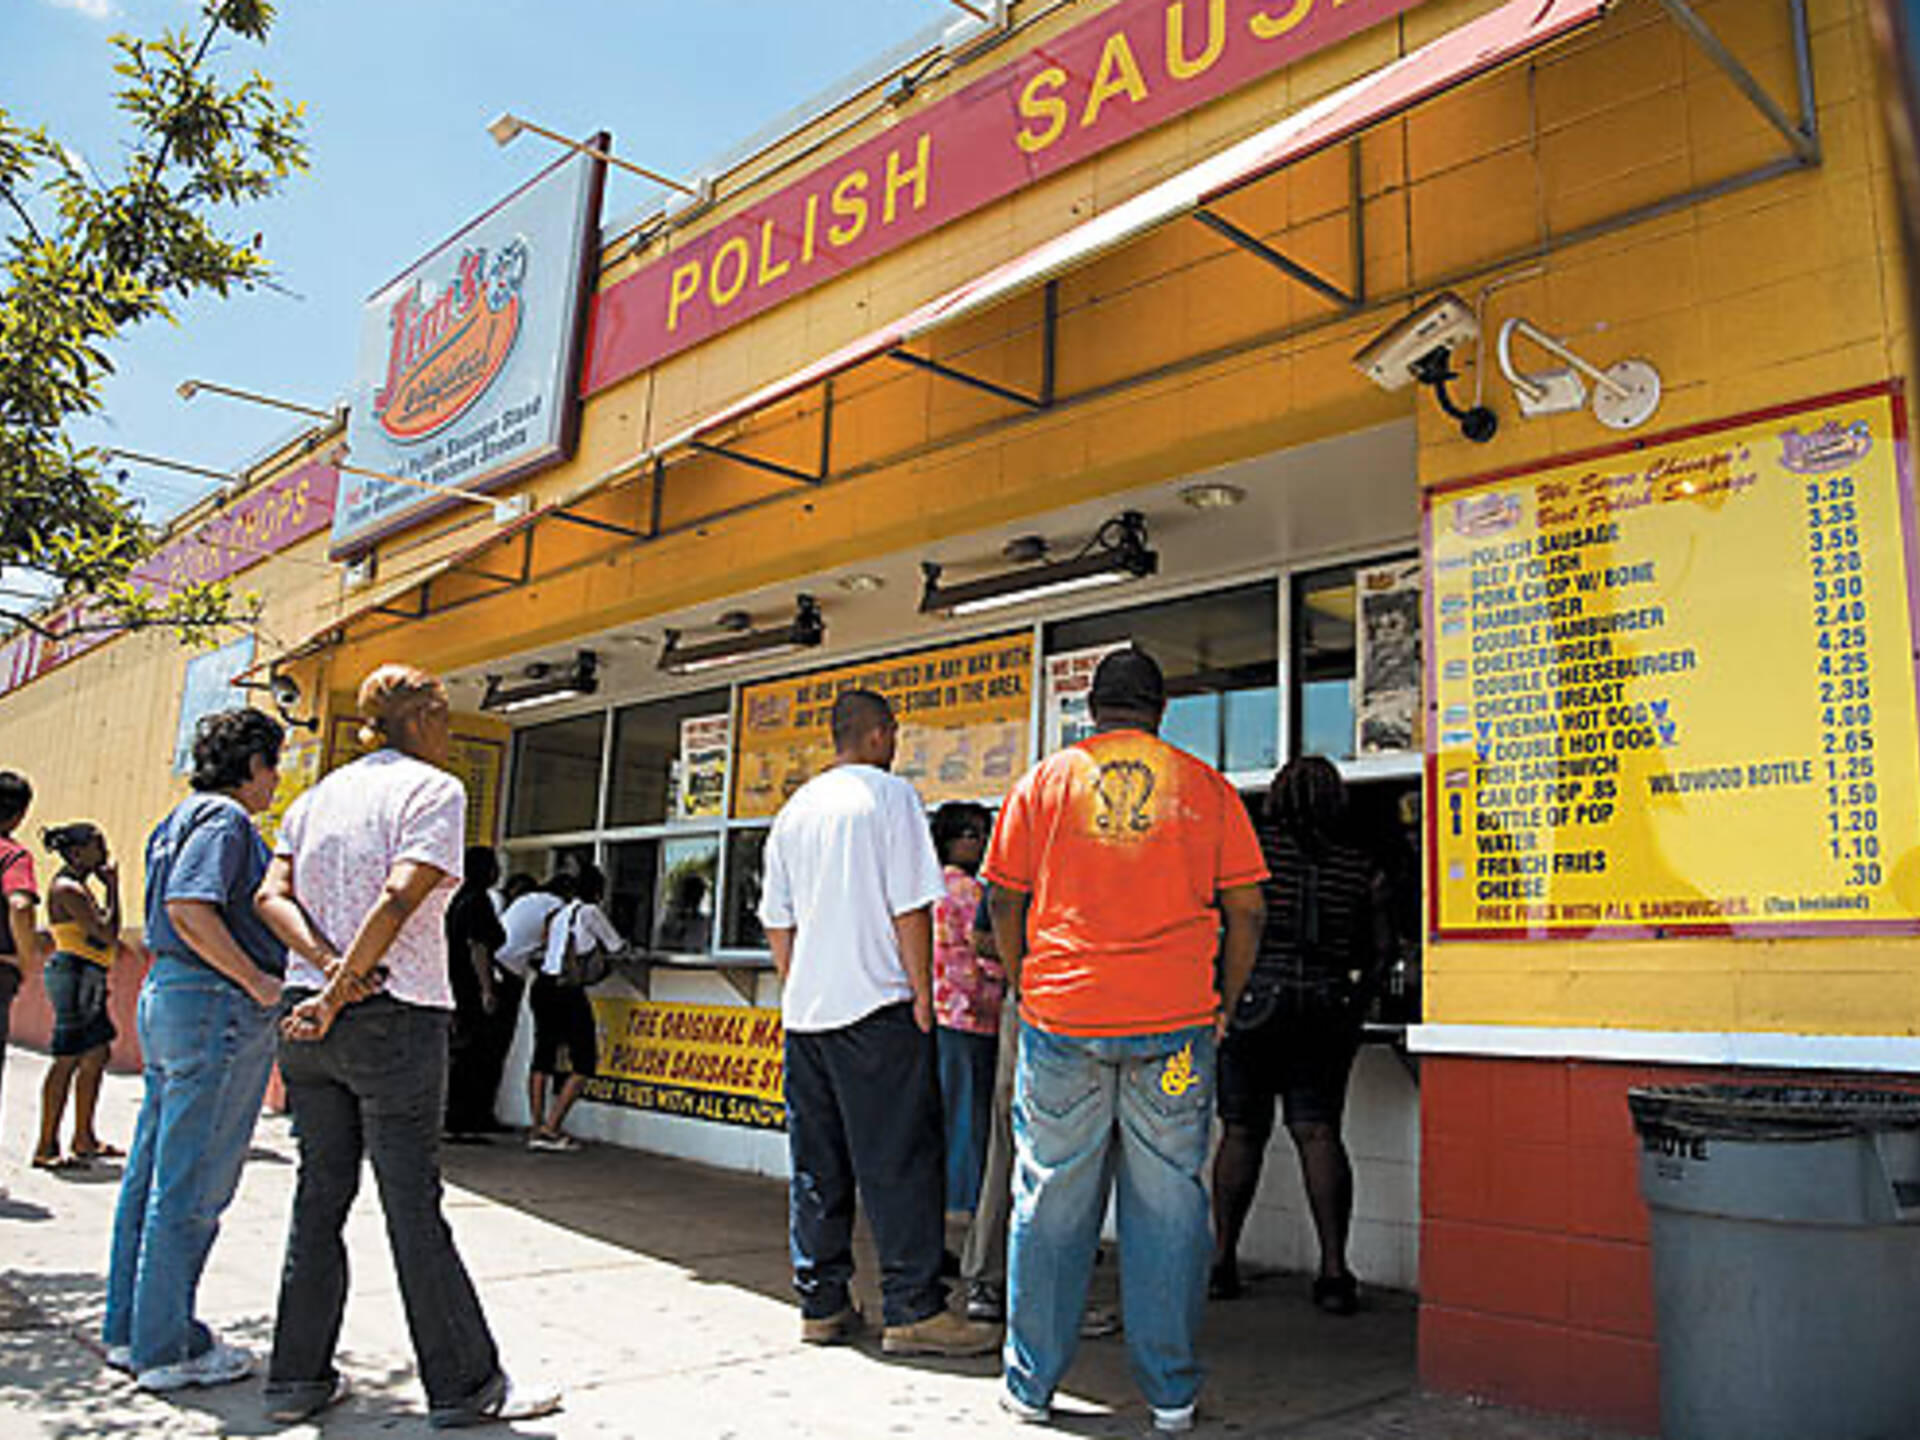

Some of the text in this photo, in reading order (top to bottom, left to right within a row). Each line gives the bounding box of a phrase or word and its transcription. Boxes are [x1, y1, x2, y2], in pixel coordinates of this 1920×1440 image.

[666, 132, 931, 332] POLISH
[1472, 477, 1855, 566] POLISH SAUSAGE 3.25
[1516, 552, 1581, 581] POLISH
[1808, 501, 1857, 528] 3.35
[1473, 586, 1517, 609] PORK
[1522, 577, 1571, 601] CHOP
[1604, 562, 1654, 588] BONE
[1810, 526, 1859, 553] 3.55
[1473, 597, 1583, 631] HAMBURGER
[1473, 575, 1863, 653] DOUBLE HAMBURGER 3.90
[1473, 601, 1866, 675] CHEESEBURGER 2.40
[1473, 626, 1867, 696] DOUBLE CHEESEBURGER 4.25
[1475, 652, 1870, 718] CHICKEN BREAST 4.25
[1562, 708, 1600, 731] HOT
[1605, 702, 1648, 727] DOG
[1819, 677, 1870, 703] 2.35
[1476, 730, 1874, 785] FISH SANDWICH 2.65
[1496, 735, 1565, 761] DOUBLE
[1569, 731, 1607, 753] HOT
[1612, 726, 1656, 750] DOG
[1476, 756, 1874, 808] CAN OF POP .85 WILDWOOD BOTTLE 1.25
[1476, 782, 1878, 831] BOTTLE OF POP 1.50
[1476, 809, 1878, 854] WATER 1.20
[1476, 834, 1880, 877] FRENCH FRIES 1.10
[1476, 862, 1882, 901] CHEESE .30
[1605, 901, 1635, 920] ALL
[628, 1008, 784, 1054] THE ORIGINAL MA
[611, 1043, 784, 1092] POLISH SAUSAGE ST
[696, 1094, 726, 1120] ALL
[727, 1097, 786, 1127] SANDW
